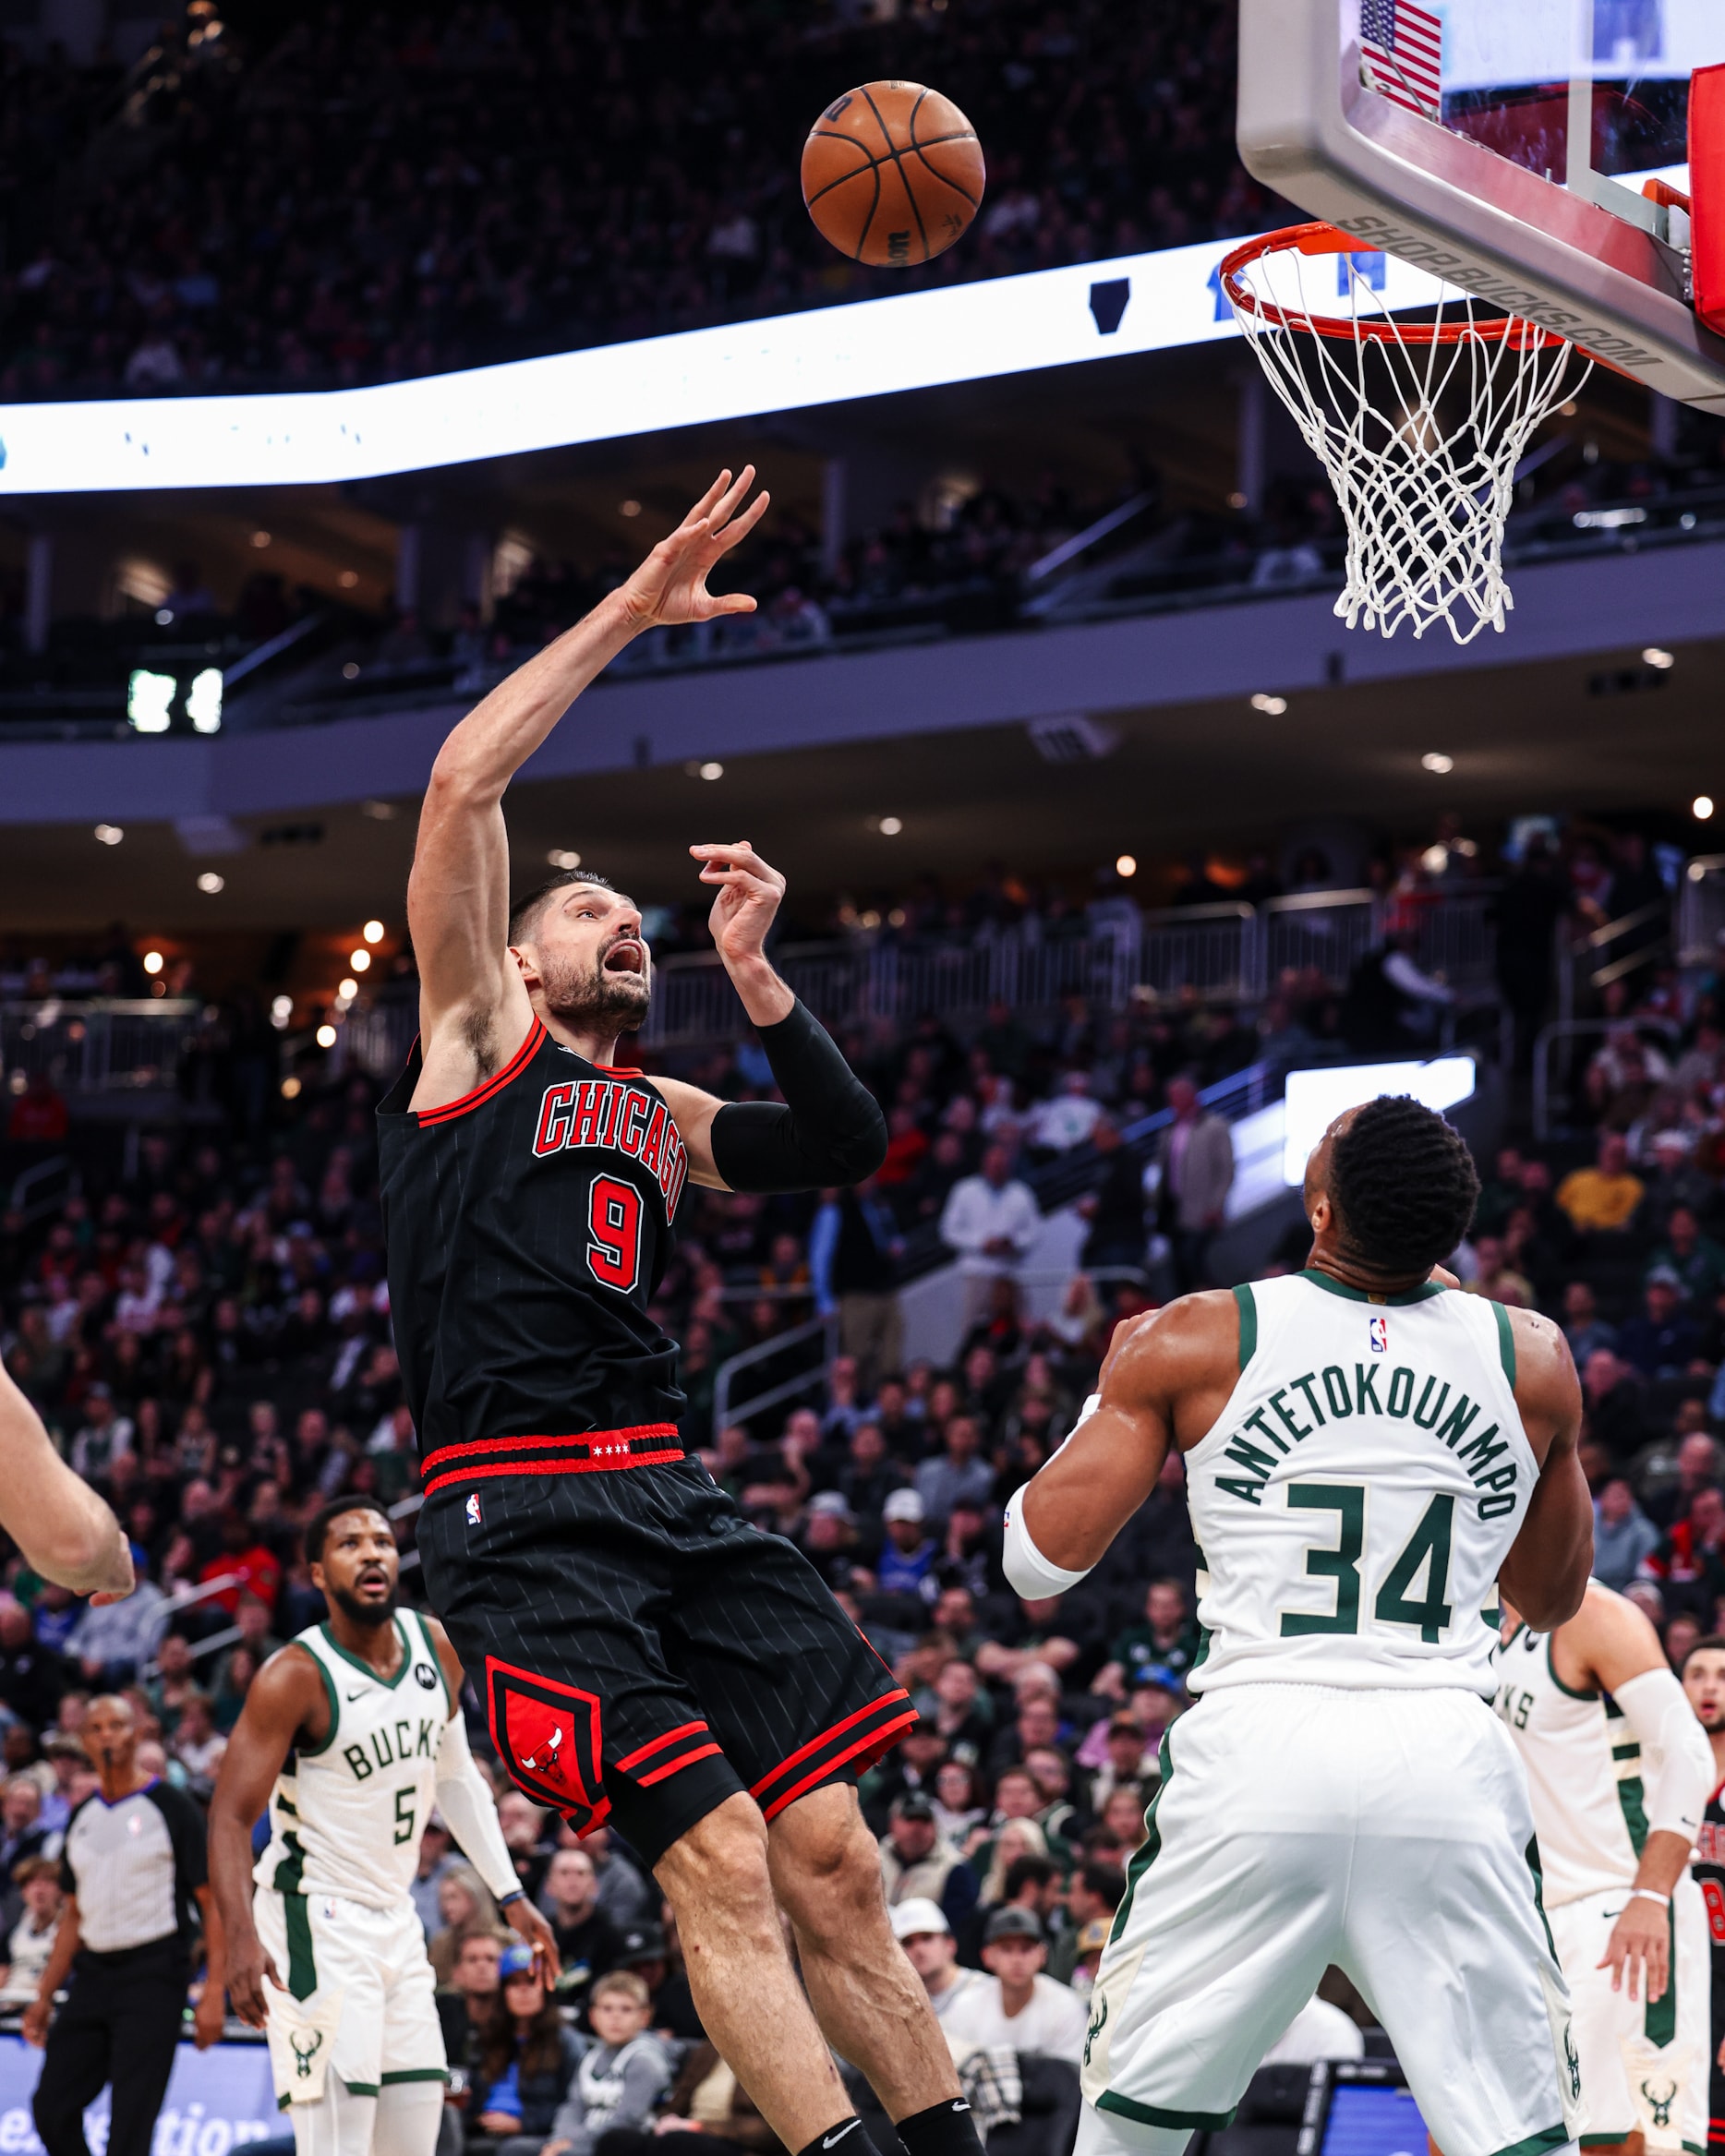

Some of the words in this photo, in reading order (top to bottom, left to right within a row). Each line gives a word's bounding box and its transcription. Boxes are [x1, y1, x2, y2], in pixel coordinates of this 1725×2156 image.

[1337, 215, 1664, 367] SHOP.BUCKS.COM
[532, 1079, 688, 1227] CHICAGO
[586, 1172, 644, 1295] 9
[1214, 1362, 1517, 1521] ANTETOKOUNMPO
[1280, 1482, 1459, 1644] 34
[393, 1784, 416, 1846] 5
